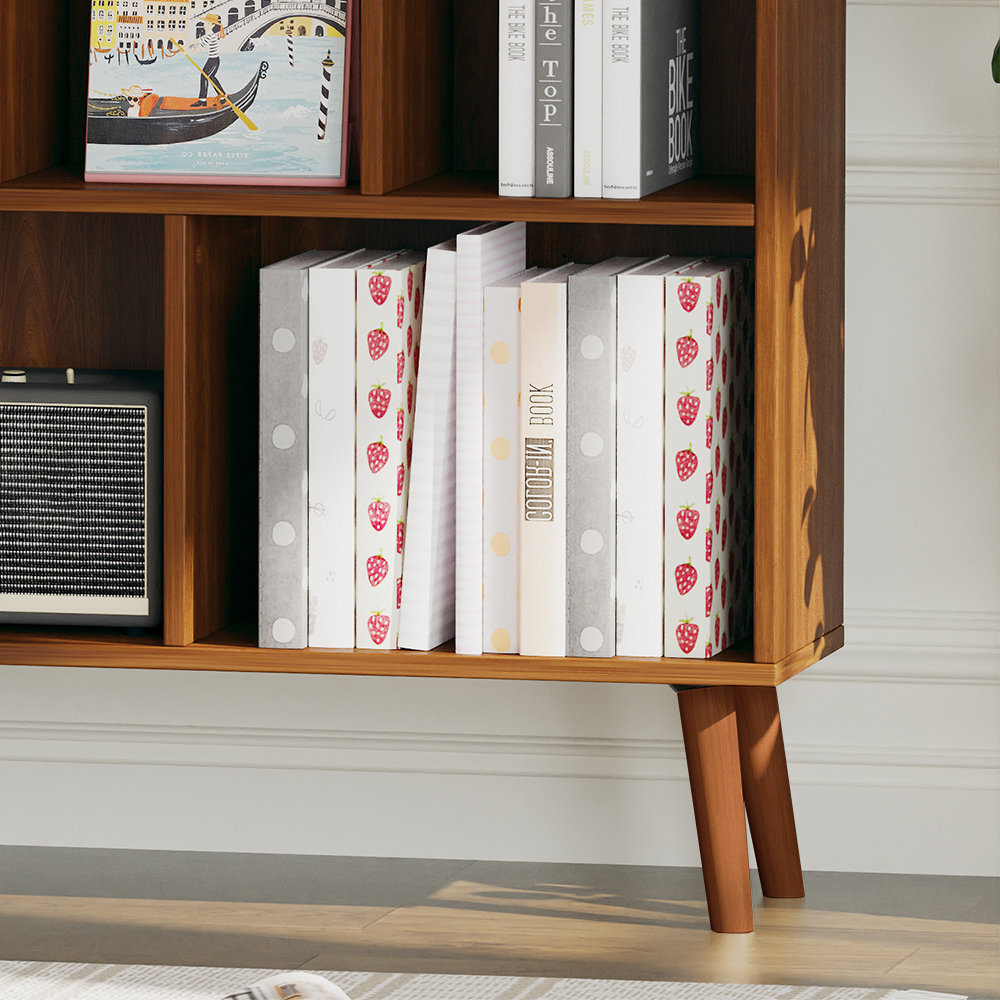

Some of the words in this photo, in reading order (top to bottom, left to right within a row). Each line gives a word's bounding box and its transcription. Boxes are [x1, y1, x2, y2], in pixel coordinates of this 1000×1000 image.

[508, 5, 526, 19] THE
[612, 6, 629, 21] THE
[508, 22, 526, 39] BIKE
[612, 24, 629, 41] BIKE
[675, 26, 687, 56] THE
[508, 42, 526, 62] BOOK
[612, 44, 629, 63] BOOK
[542, 60, 559, 122] Top
[668, 52, 694, 117] BIKE
[668, 111, 693, 164] BOOK
[546, 146, 554, 185] ASSOULINE
